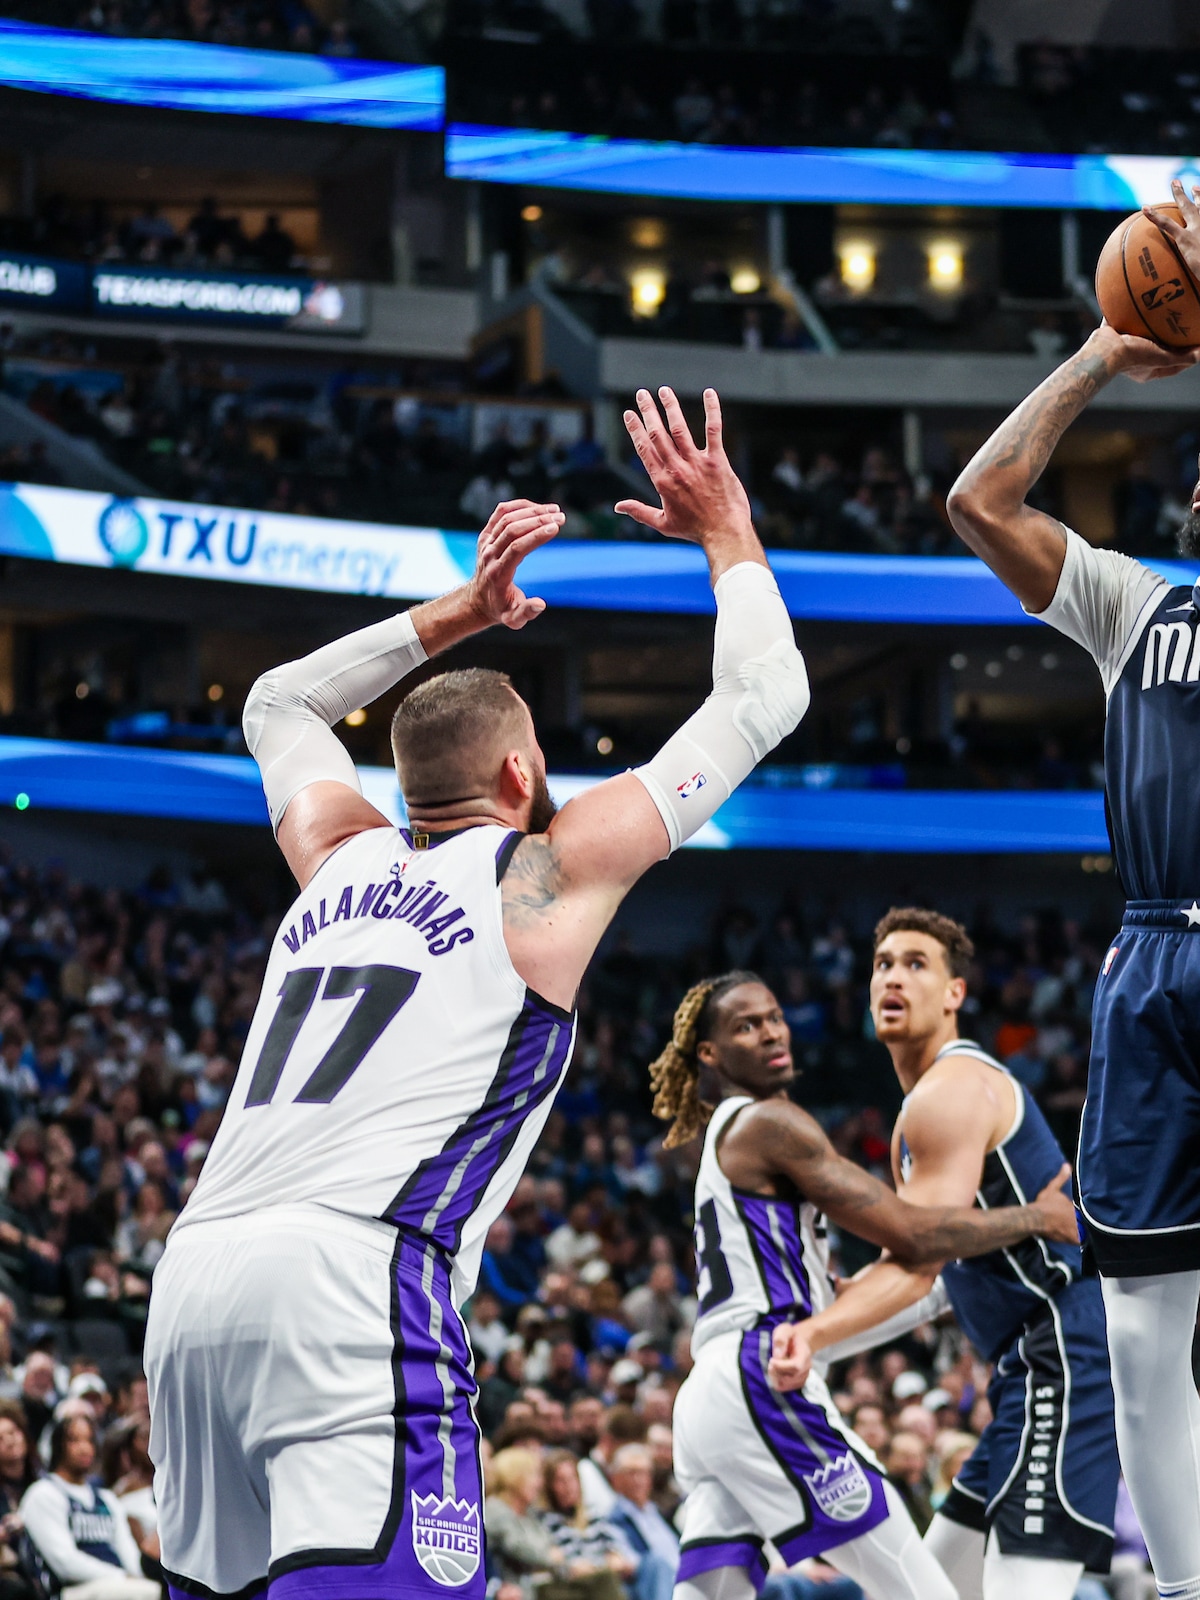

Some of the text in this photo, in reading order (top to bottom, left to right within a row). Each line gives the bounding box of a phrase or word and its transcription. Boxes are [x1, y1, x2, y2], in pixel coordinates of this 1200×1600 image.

[243, 964, 422, 1110] 17
[418, 1516, 477, 1536] SACRAMENTO
[416, 1528, 479, 1556] KINGS
